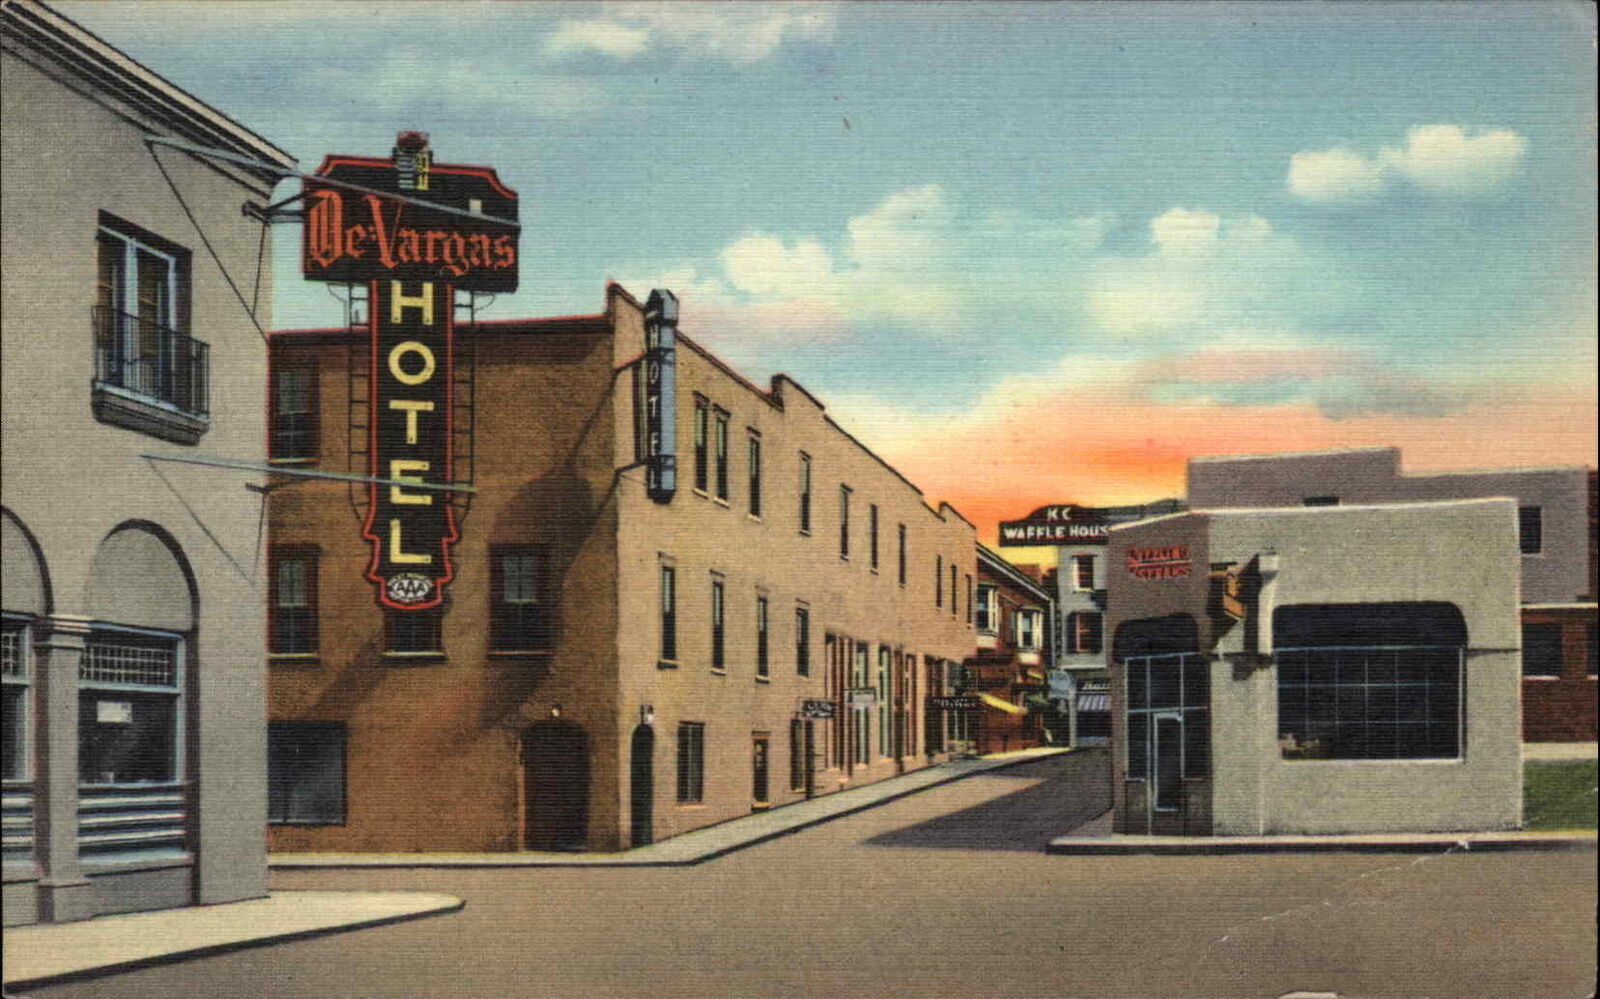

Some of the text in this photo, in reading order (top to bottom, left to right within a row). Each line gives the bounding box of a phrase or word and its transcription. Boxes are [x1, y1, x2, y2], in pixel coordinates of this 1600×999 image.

[388, 279, 436, 564] HOTEL
[648, 323, 661, 491] HOTEL
[1003, 524, 1066, 540] WAFFLE
